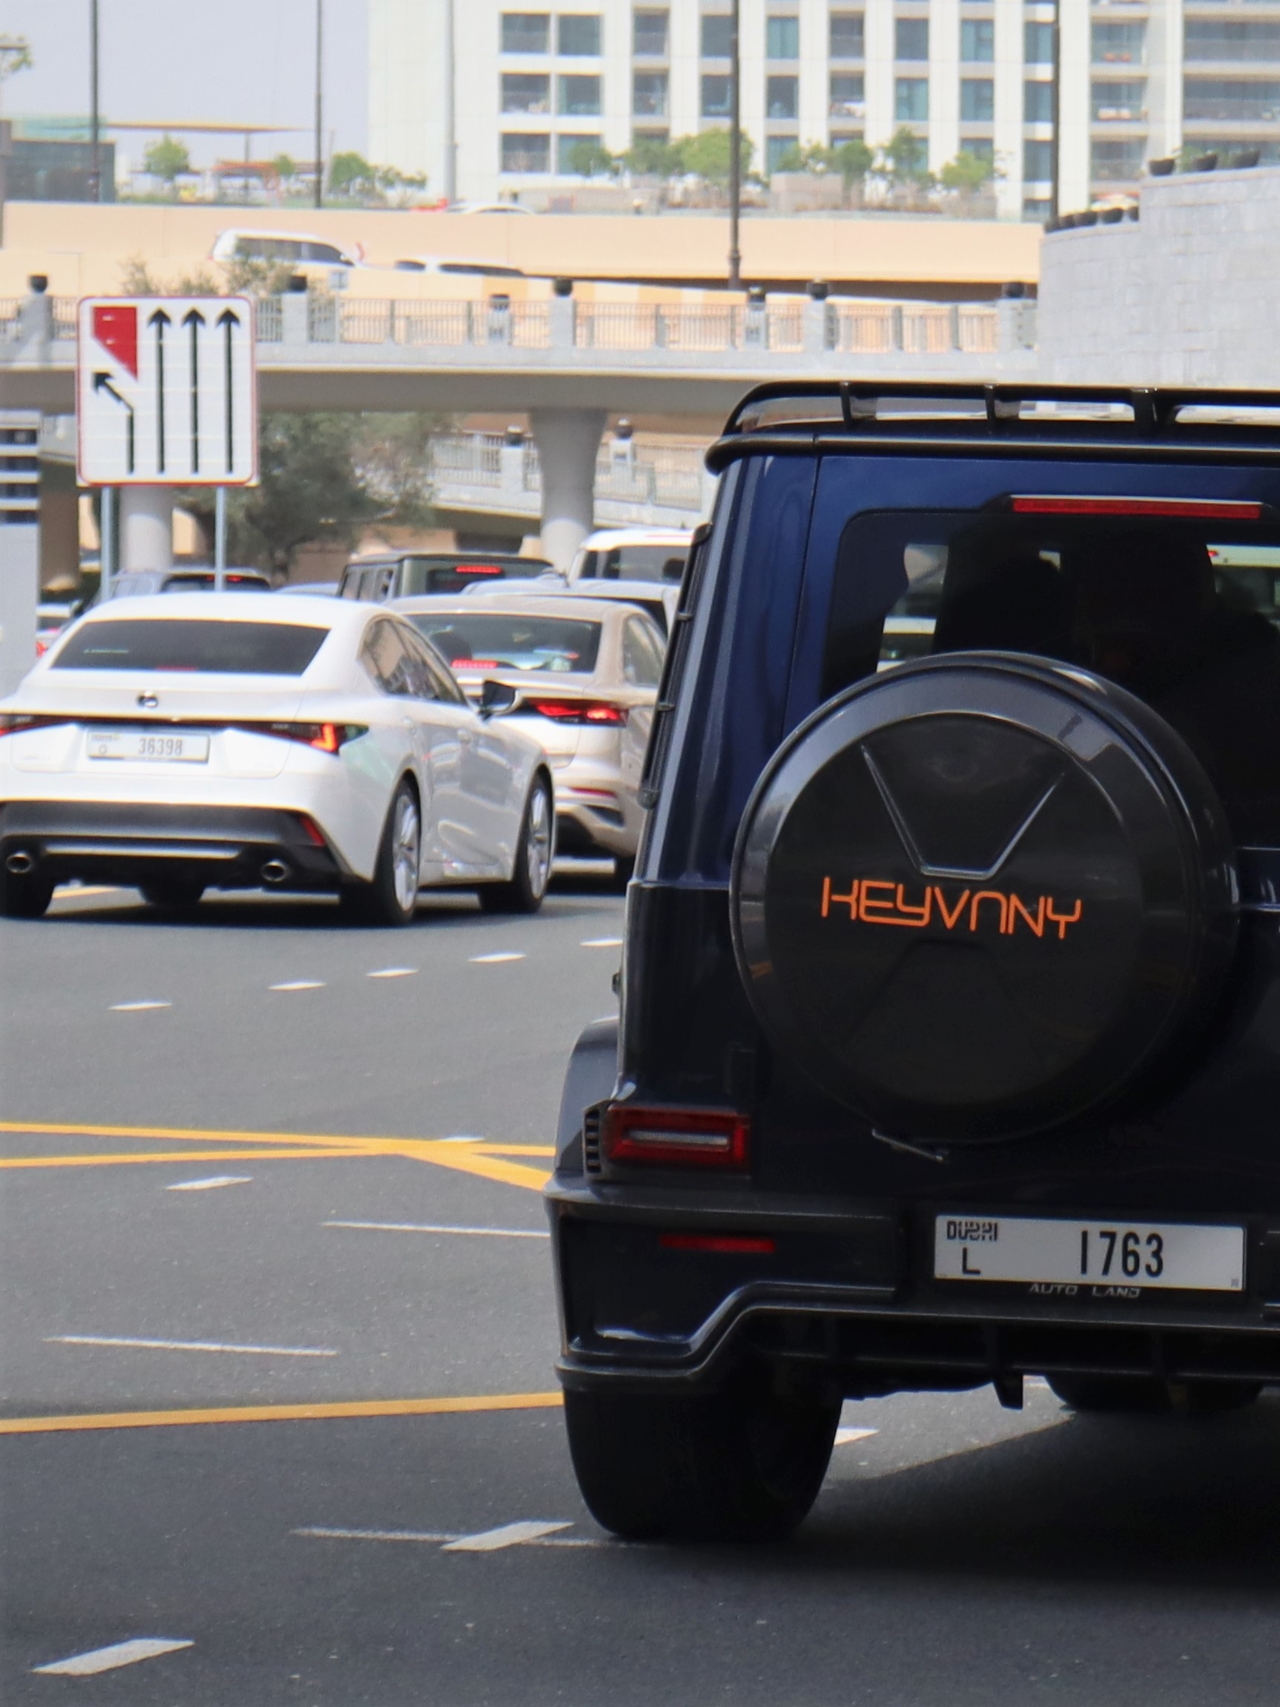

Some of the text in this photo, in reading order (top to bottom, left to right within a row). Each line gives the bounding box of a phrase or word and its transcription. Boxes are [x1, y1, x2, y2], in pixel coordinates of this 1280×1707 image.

[139, 737, 183, 756] 36398
[962, 1247, 981, 1275] L
[1080, 1230, 1164, 1278] 1763
[1029, 1283, 1141, 1298] AUTO LAND
